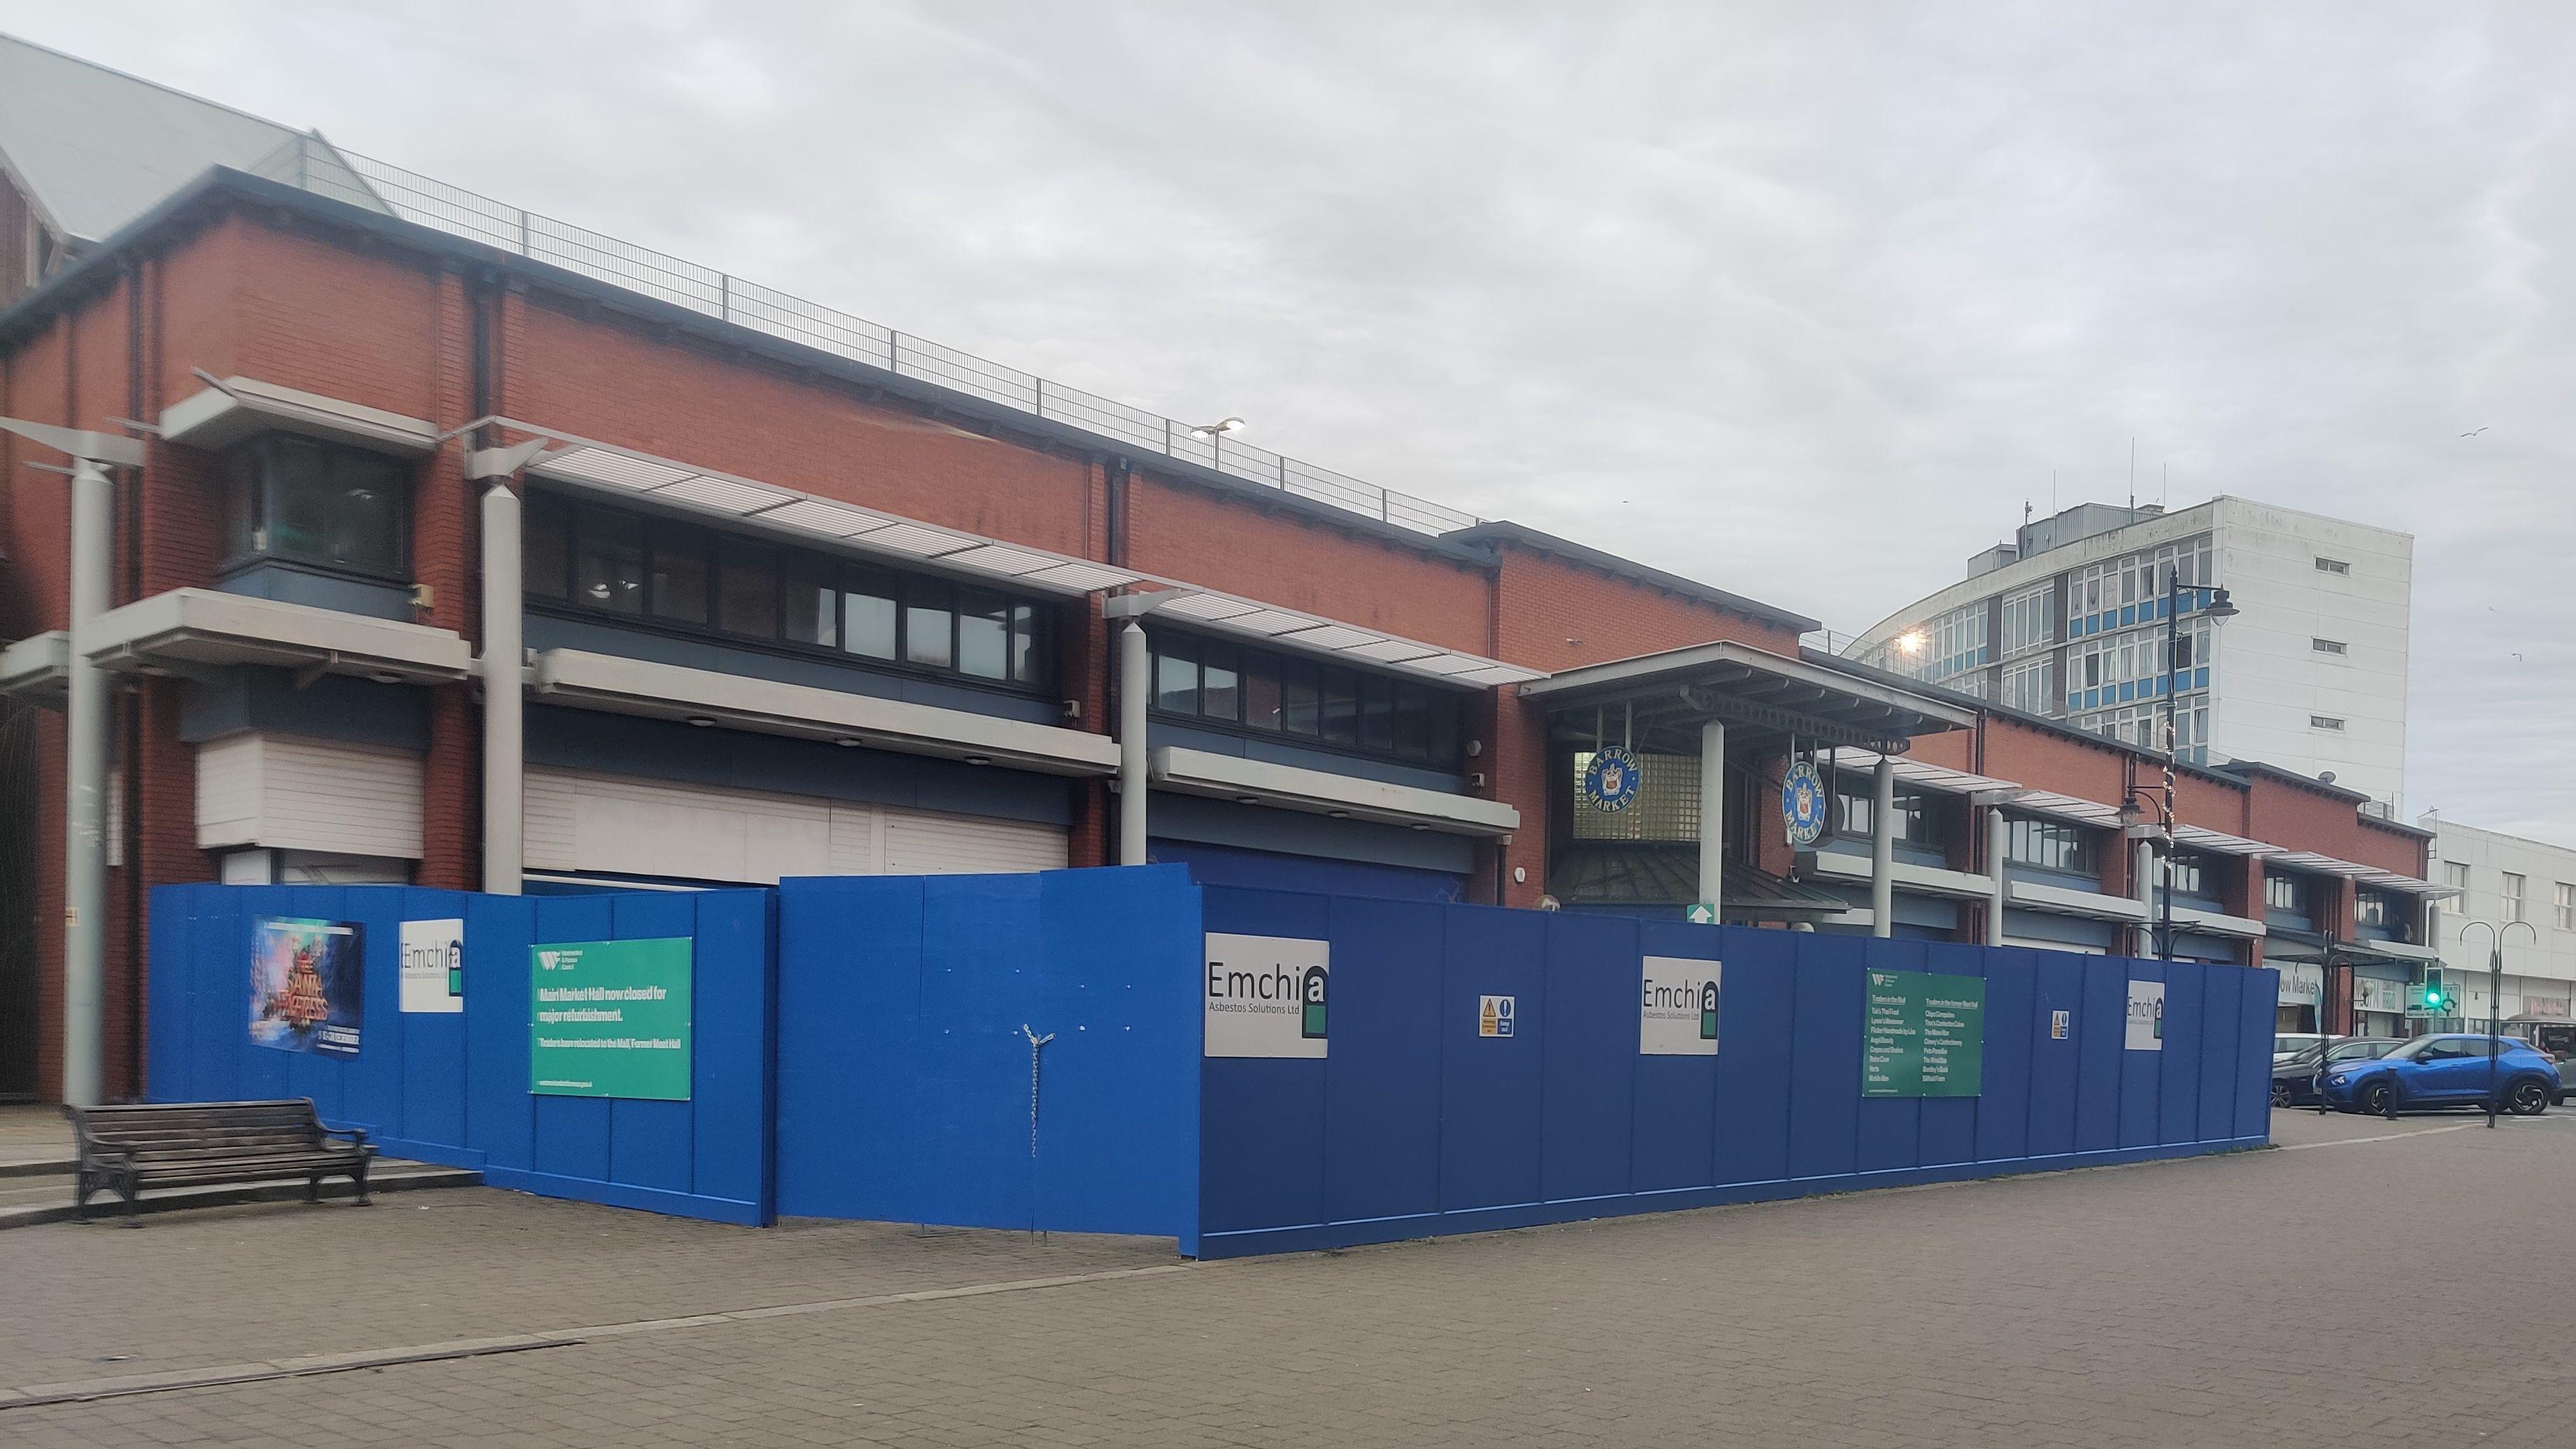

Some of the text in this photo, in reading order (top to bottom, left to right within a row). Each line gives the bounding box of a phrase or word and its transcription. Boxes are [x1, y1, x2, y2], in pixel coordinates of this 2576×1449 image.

[1589, 749, 1638, 776] BARROW
[1786, 765, 1823, 797] BARROW
[1589, 785, 1635, 811] MARKET
[1786, 809, 1821, 839] MARKET
[401, 941, 461, 968] Emchia
[538, 985, 667, 1001] Main Market Hall now closed for
[1209, 962, 1325, 1003] Emchia
[1643, 979, 1715, 1011] Emchia
[2280, 979, 2291, 992] ow
[539, 1008, 624, 1024] major refurbishment.
[1209, 1001, 1299, 1015] Asbestos Solutions Ltd
[1668, 1011, 1690, 1020] Solutions
[2128, 997, 2162, 1019] Emchia
